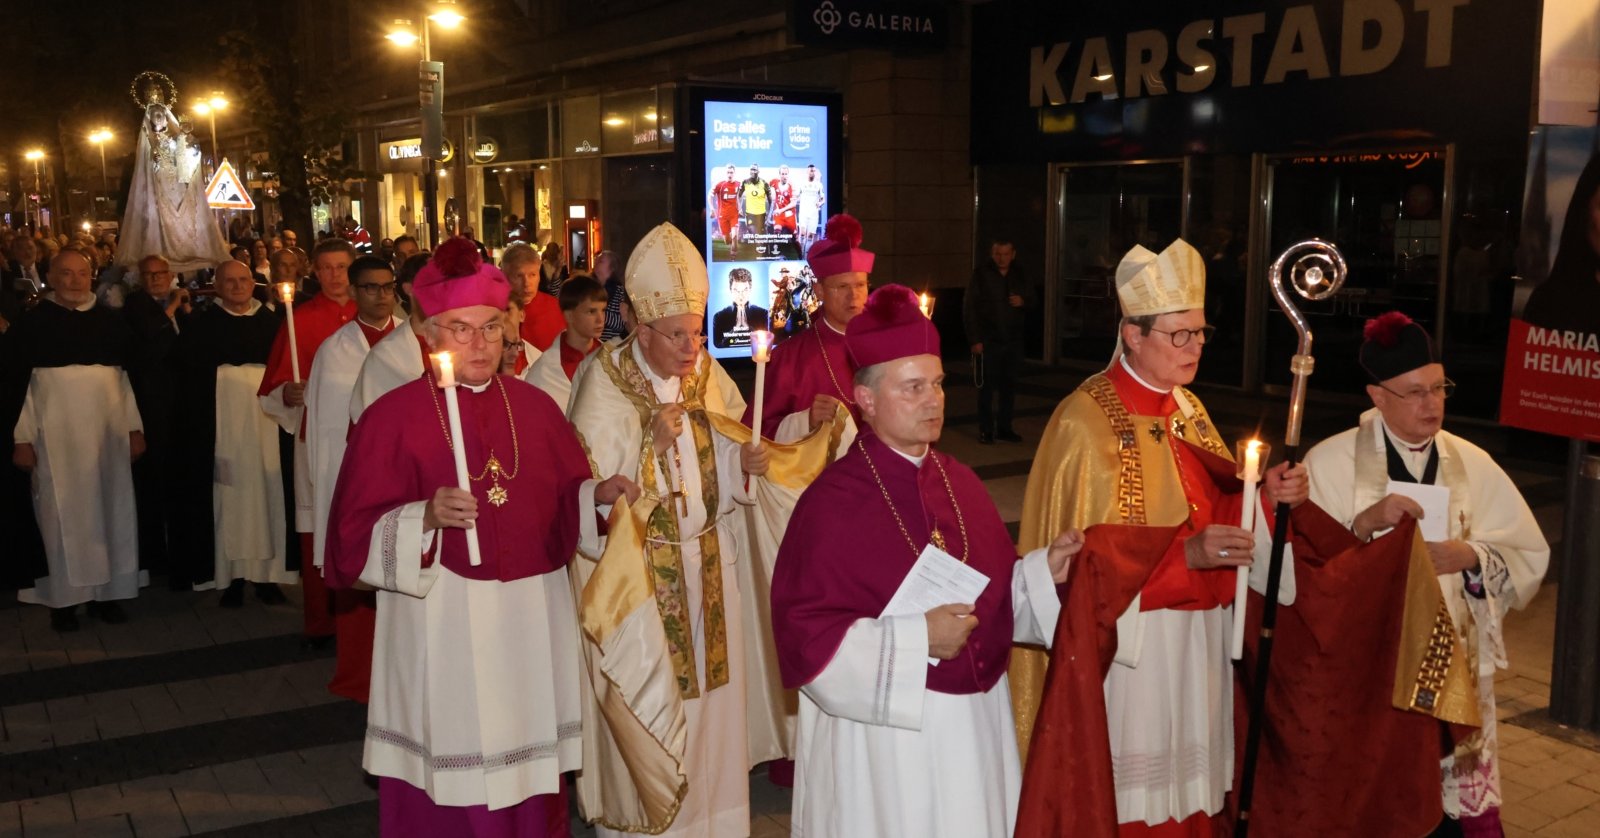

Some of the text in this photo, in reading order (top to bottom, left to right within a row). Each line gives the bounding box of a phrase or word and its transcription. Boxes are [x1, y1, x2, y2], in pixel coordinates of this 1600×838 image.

[848, 11, 934, 33] GALERIA
[1029, 0, 1471, 107] KARSTADT
[752, 93, 784, 101] JCDecaux
[713, 120, 766, 134] Das alles
[789, 125, 811, 135] prime
[713, 137, 774, 151] gibt's hier
[789, 135, 811, 143] video
[1526, 326, 1600, 353] MARIA
[1523, 351, 1600, 379] HELMIS
